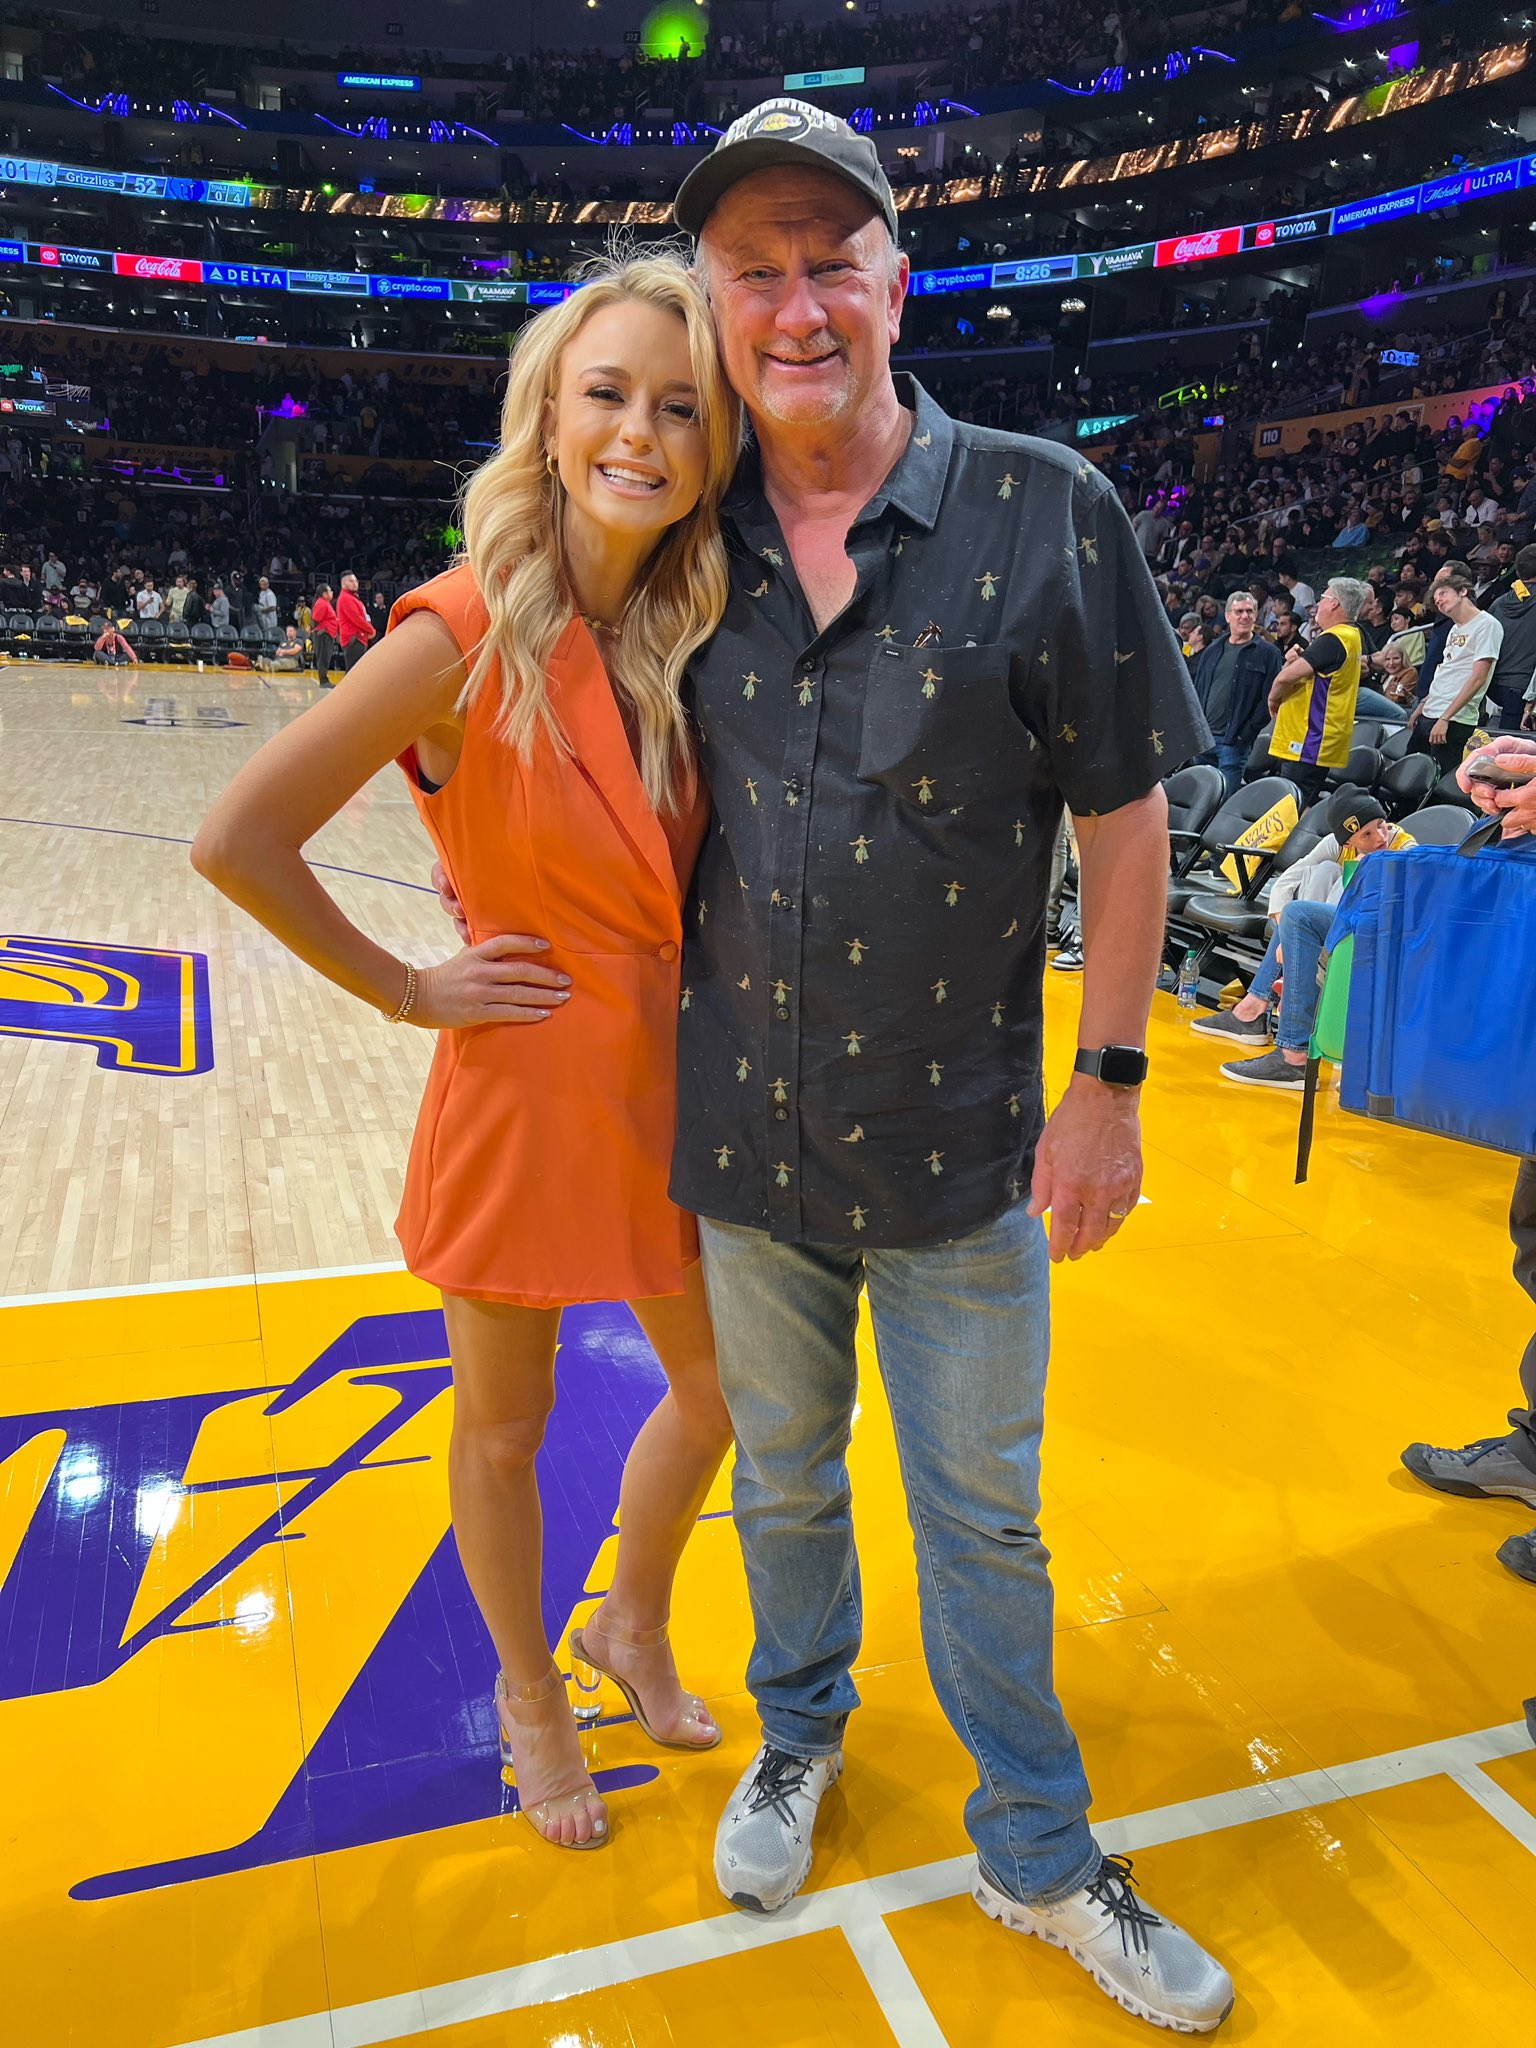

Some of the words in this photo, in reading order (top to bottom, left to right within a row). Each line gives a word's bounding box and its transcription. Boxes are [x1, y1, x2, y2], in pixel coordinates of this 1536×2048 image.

[344, 76, 380, 85] AMERICAN
[381, 79, 414, 87] EXPRESS
[45, 170, 53, 184] 3
[66, 171, 115, 187] Grizzlies
[135, 177, 157, 194] 52
[1423, 183, 1462, 203] Michelob
[1472, 169, 1513, 190] ULTRA
[215, 191, 222, 201] 0
[233, 193, 241, 203] 4
[1338, 206, 1377, 224] AMERICAN
[1378, 196, 1415, 213] EXPRESS
[1275, 219, 1316, 239] TOYOTA
[1174, 233, 1221, 260] Coca-Cola
[60, 252, 100, 266] TOYOTA
[135, 257, 181, 278] Coca-Cola
[1015, 263, 1050, 281] 8:26
[227, 269, 281, 285] DELTA
[937, 272, 984, 288] crypto.com
[392, 283, 441, 294] crypto.com
[14, 403, 42, 412] TOYOTA
[1262, 430, 1278, 443] 110
